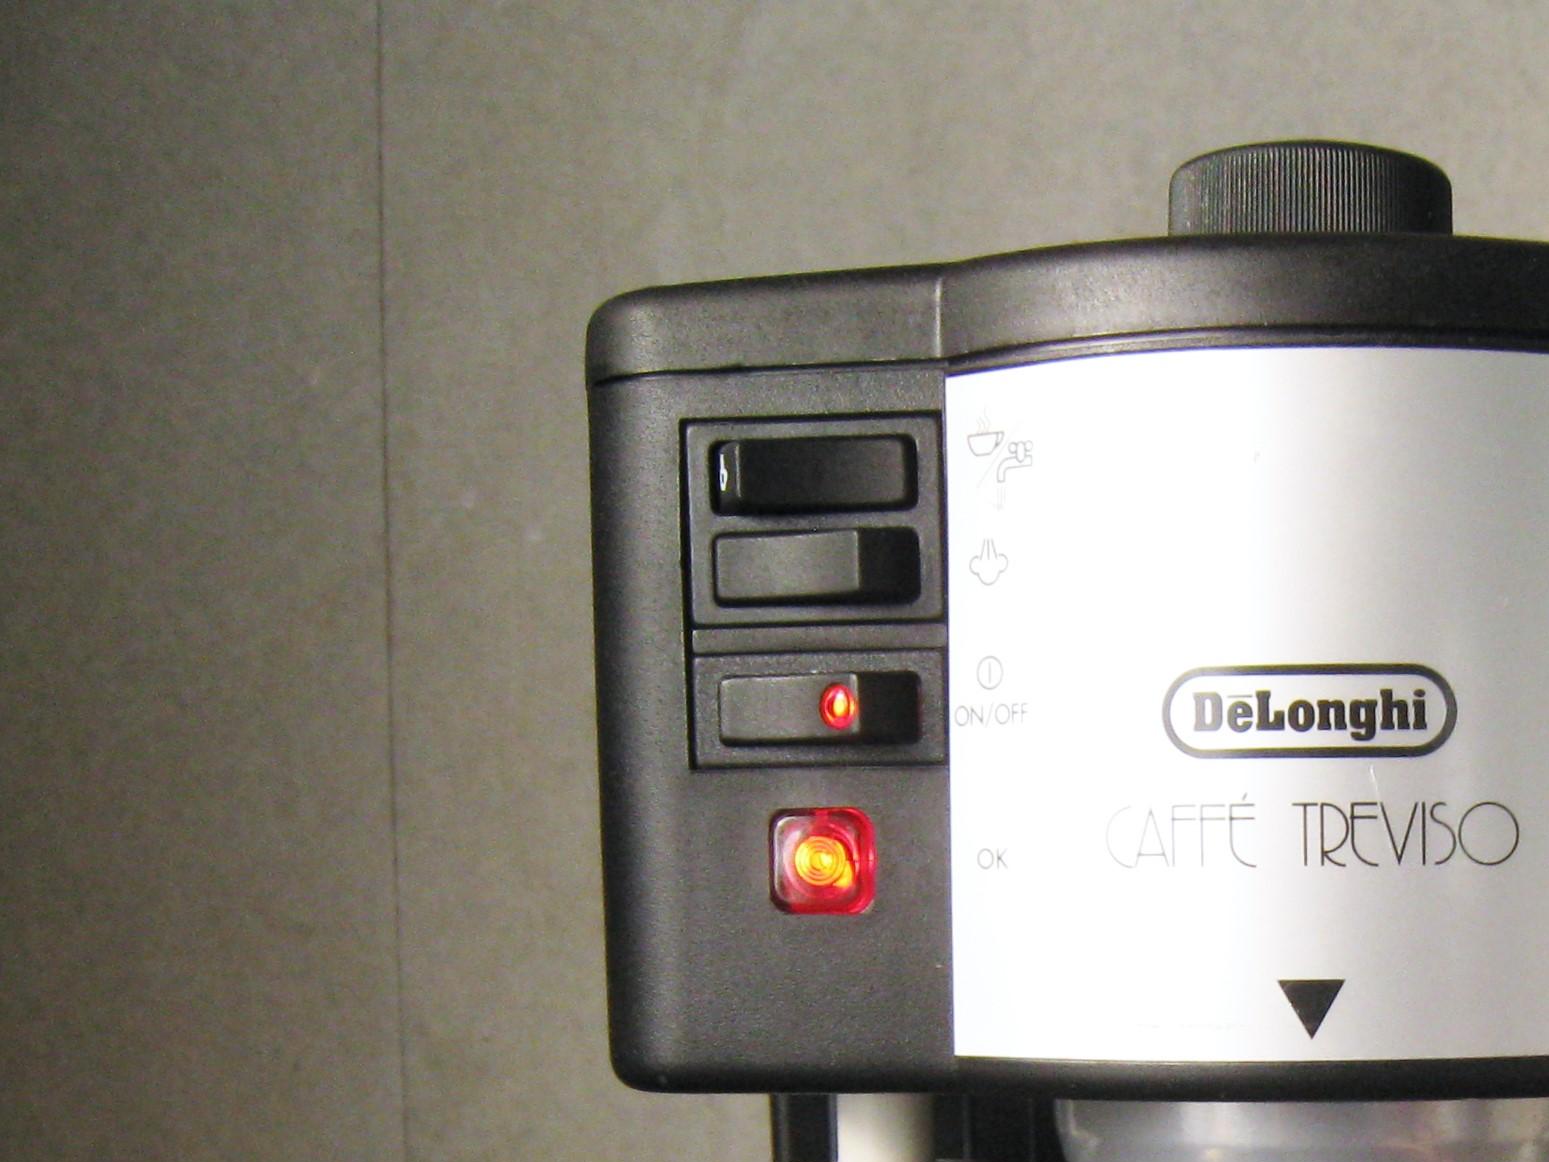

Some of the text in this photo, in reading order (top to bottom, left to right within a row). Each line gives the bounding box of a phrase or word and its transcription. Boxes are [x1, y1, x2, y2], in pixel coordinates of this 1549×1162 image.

[954, 702, 1029, 727] ON/OFF
[1106, 793, 1520, 869] CAFFÉ TREVISO
[976, 848, 1009, 870] OK
